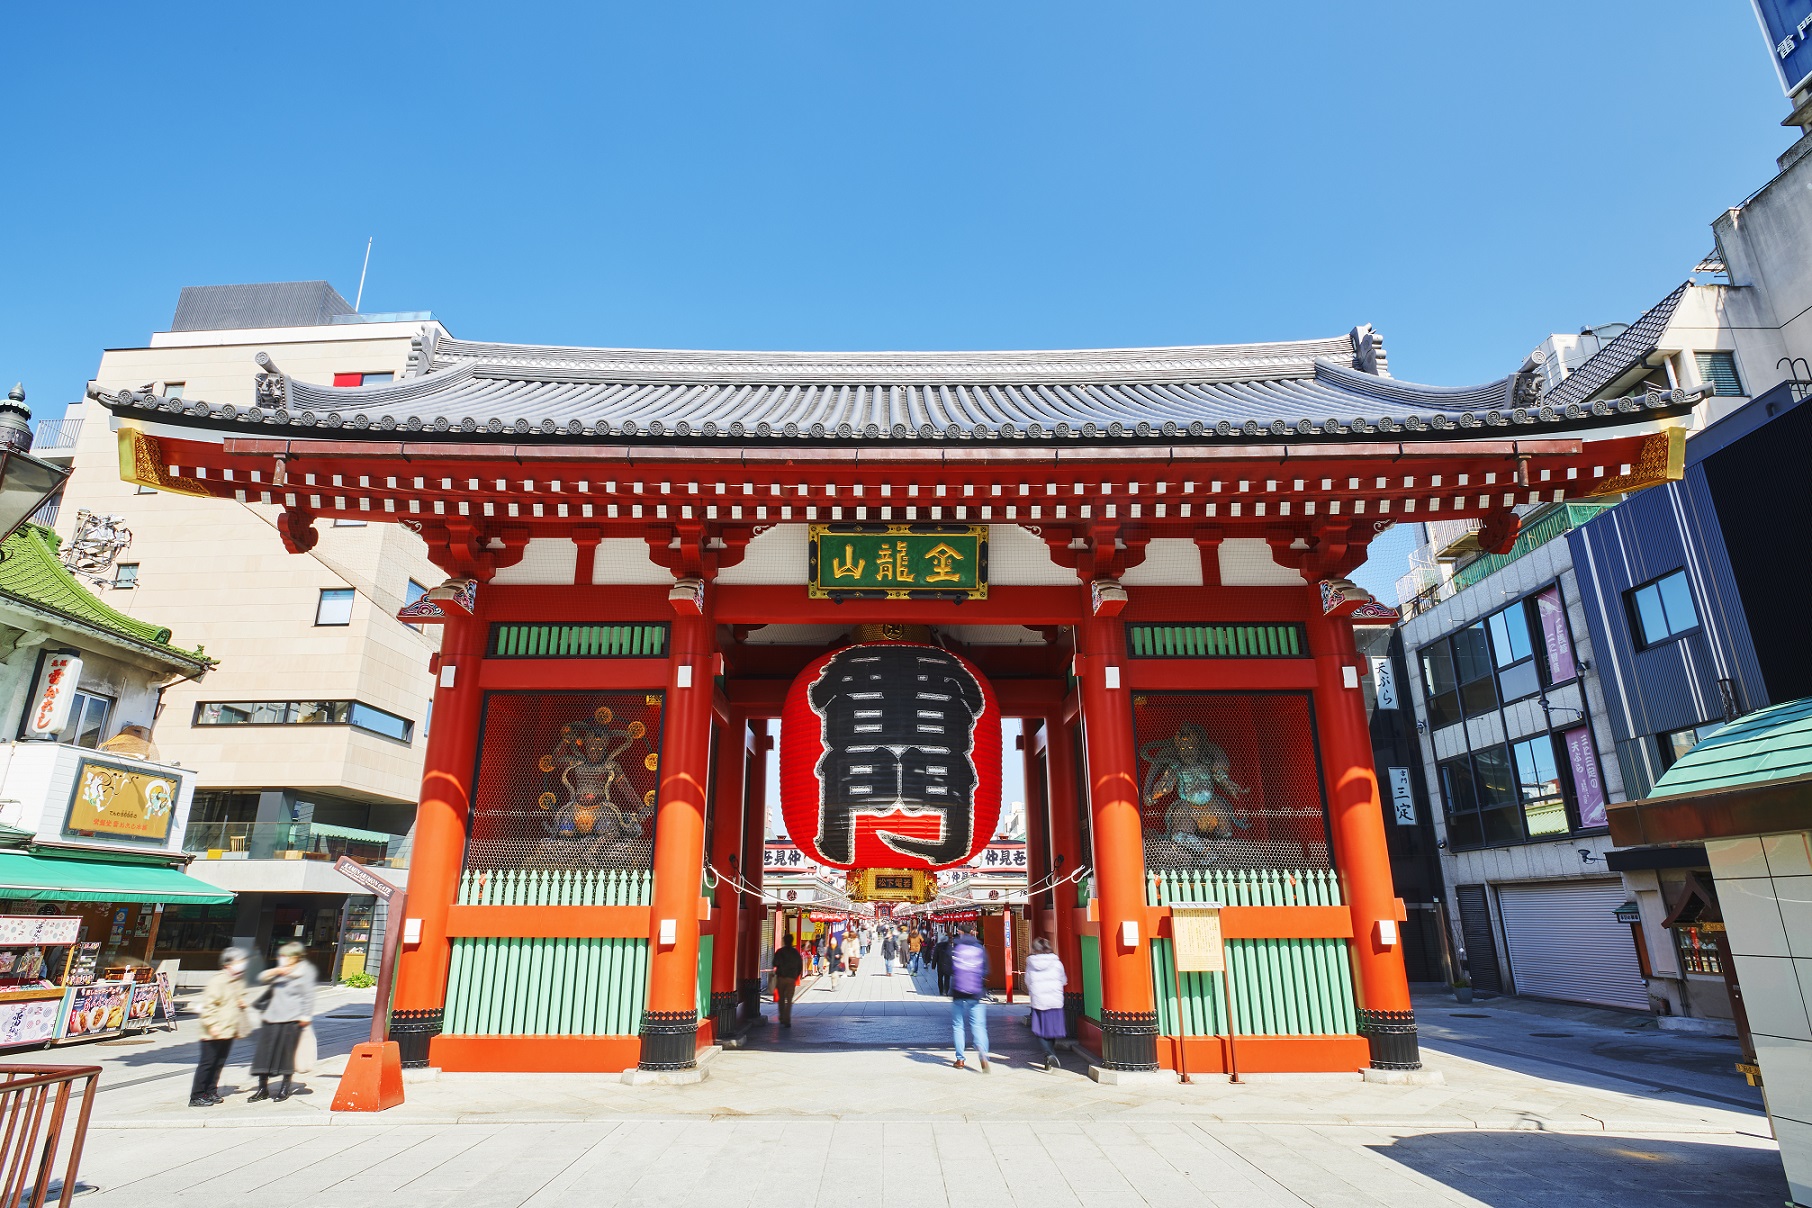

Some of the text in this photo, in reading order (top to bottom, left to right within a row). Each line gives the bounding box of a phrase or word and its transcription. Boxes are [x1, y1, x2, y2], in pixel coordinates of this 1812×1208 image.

[1375, 662, 1392, 705] 天ぷら
[807, 644, 986, 866] 雷門
[1571, 741, 1584, 773] 天ぷら
[1394, 787, 1414, 821] 三定
[985, 849, 1027, 866] 仲見世
